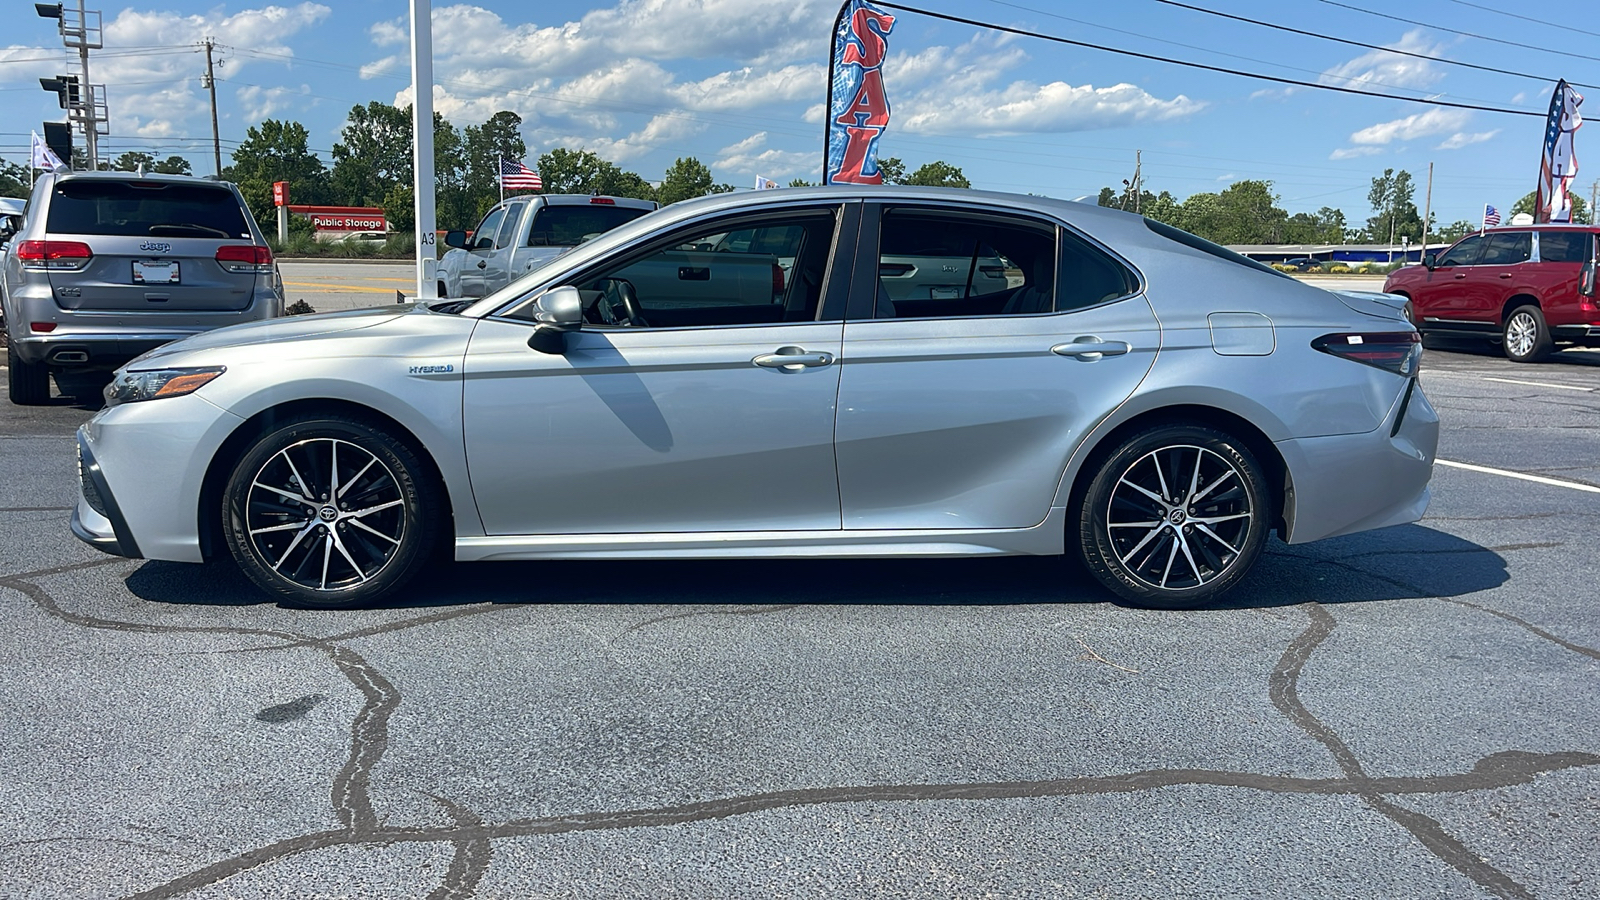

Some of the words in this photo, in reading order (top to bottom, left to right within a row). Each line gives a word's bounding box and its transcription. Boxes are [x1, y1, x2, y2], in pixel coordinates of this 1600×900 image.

[314, 218, 343, 227] Public
[344, 218, 382, 229] Storage
[421, 232, 435, 245] A3
[140, 240, 171, 254] Jeep
[409, 365, 447, 374] HYBRID
